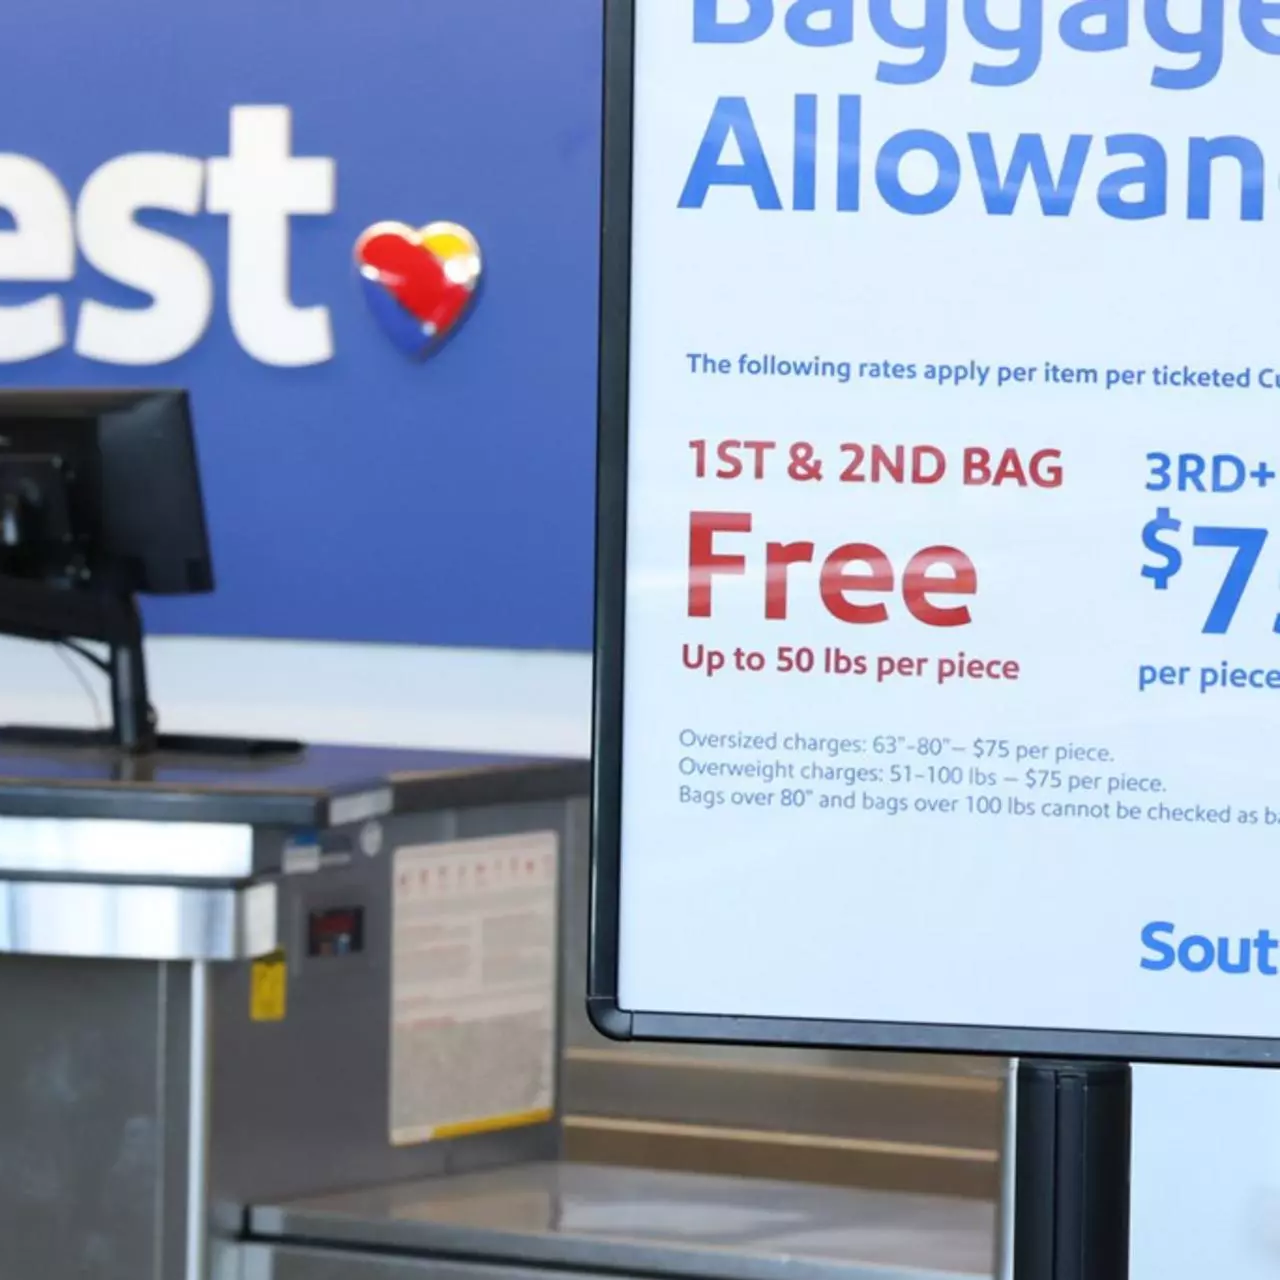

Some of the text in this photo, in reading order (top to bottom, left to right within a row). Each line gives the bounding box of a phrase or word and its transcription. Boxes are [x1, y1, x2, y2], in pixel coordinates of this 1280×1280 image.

[676, 94, 1280, 221] Allowan
[686, 353, 732, 374] The
[739, 354, 851, 383] following
[859, 360, 917, 380] rates
[924, 360, 990, 386] apply
[997, 365, 1037, 387] per
[1044, 362, 1098, 383] item
[1106, 368, 1146, 389] per
[1152, 365, 1251, 388] ticketed
[688, 439, 1064, 488] 1ST & 2ND BAG
[1145, 452, 1276, 493] 3RD+
[687, 510, 977, 627] Free
[1140, 507, 1280, 634] $7
[682, 644, 1020, 684] Up to 50 lbs per piece
[1139, 661, 1280, 694] per piece
[679, 728, 778, 750] Oversized
[783, 732, 867, 757] charges:
[972, 738, 1010, 759] $75
[1015, 744, 1050, 762] per
[1055, 742, 1115, 764] piece.
[679, 756, 795, 783] Overweight
[800, 761, 883, 785] charges:
[968, 766, 997, 786] lbs
[1024, 768, 1062, 789] $75
[1068, 774, 1102, 793] per
[1107, 772, 1167, 794] piece.
[679, 785, 726, 809] Bags
[731, 791, 775, 806] over
[819, 792, 856, 809] and
[862, 792, 908, 815] bags
[914, 797, 959, 813] over
[966, 795, 1002, 814] 100
[1007, 796, 1036, 816] lbs
[1041, 801, 1111, 820] cannot
[1116, 801, 1142, 820] be
[1146, 803, 1232, 824] checked
[1237, 810, 1258, 824] as
[1264, 806, 1280, 825] b
[1140, 920, 1278, 976] Sout
